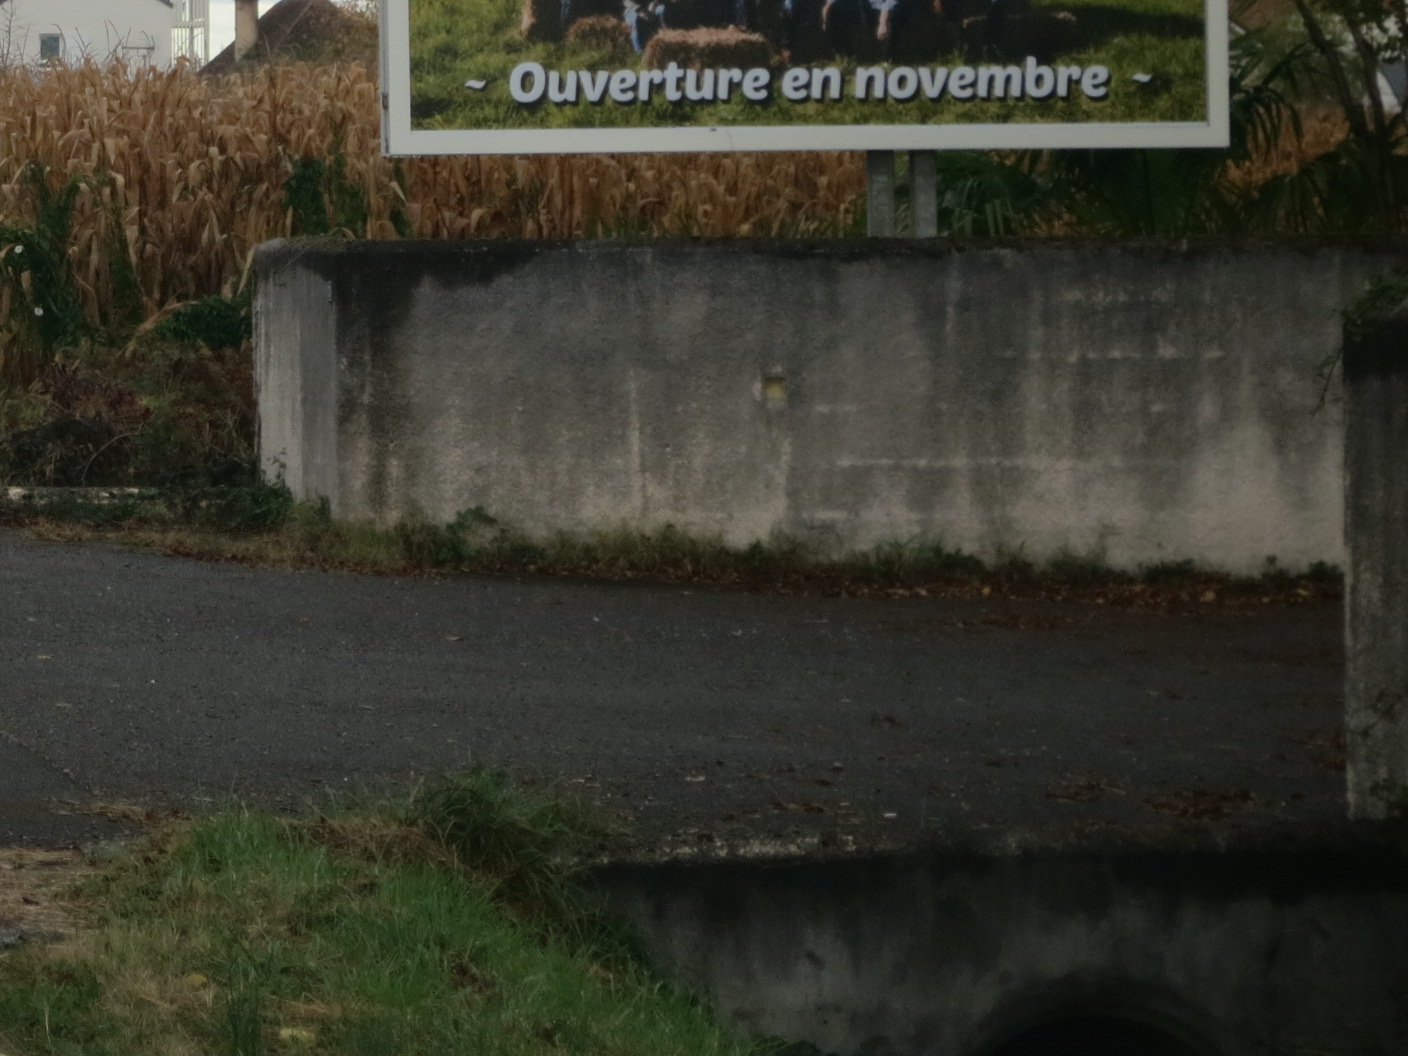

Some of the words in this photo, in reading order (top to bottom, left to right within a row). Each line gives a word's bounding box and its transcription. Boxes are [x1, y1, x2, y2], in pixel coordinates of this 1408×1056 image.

[509, 61, 771, 104] Ouverture
[782, 66, 842, 101] en
[854, 55, 1110, 100] novembre
